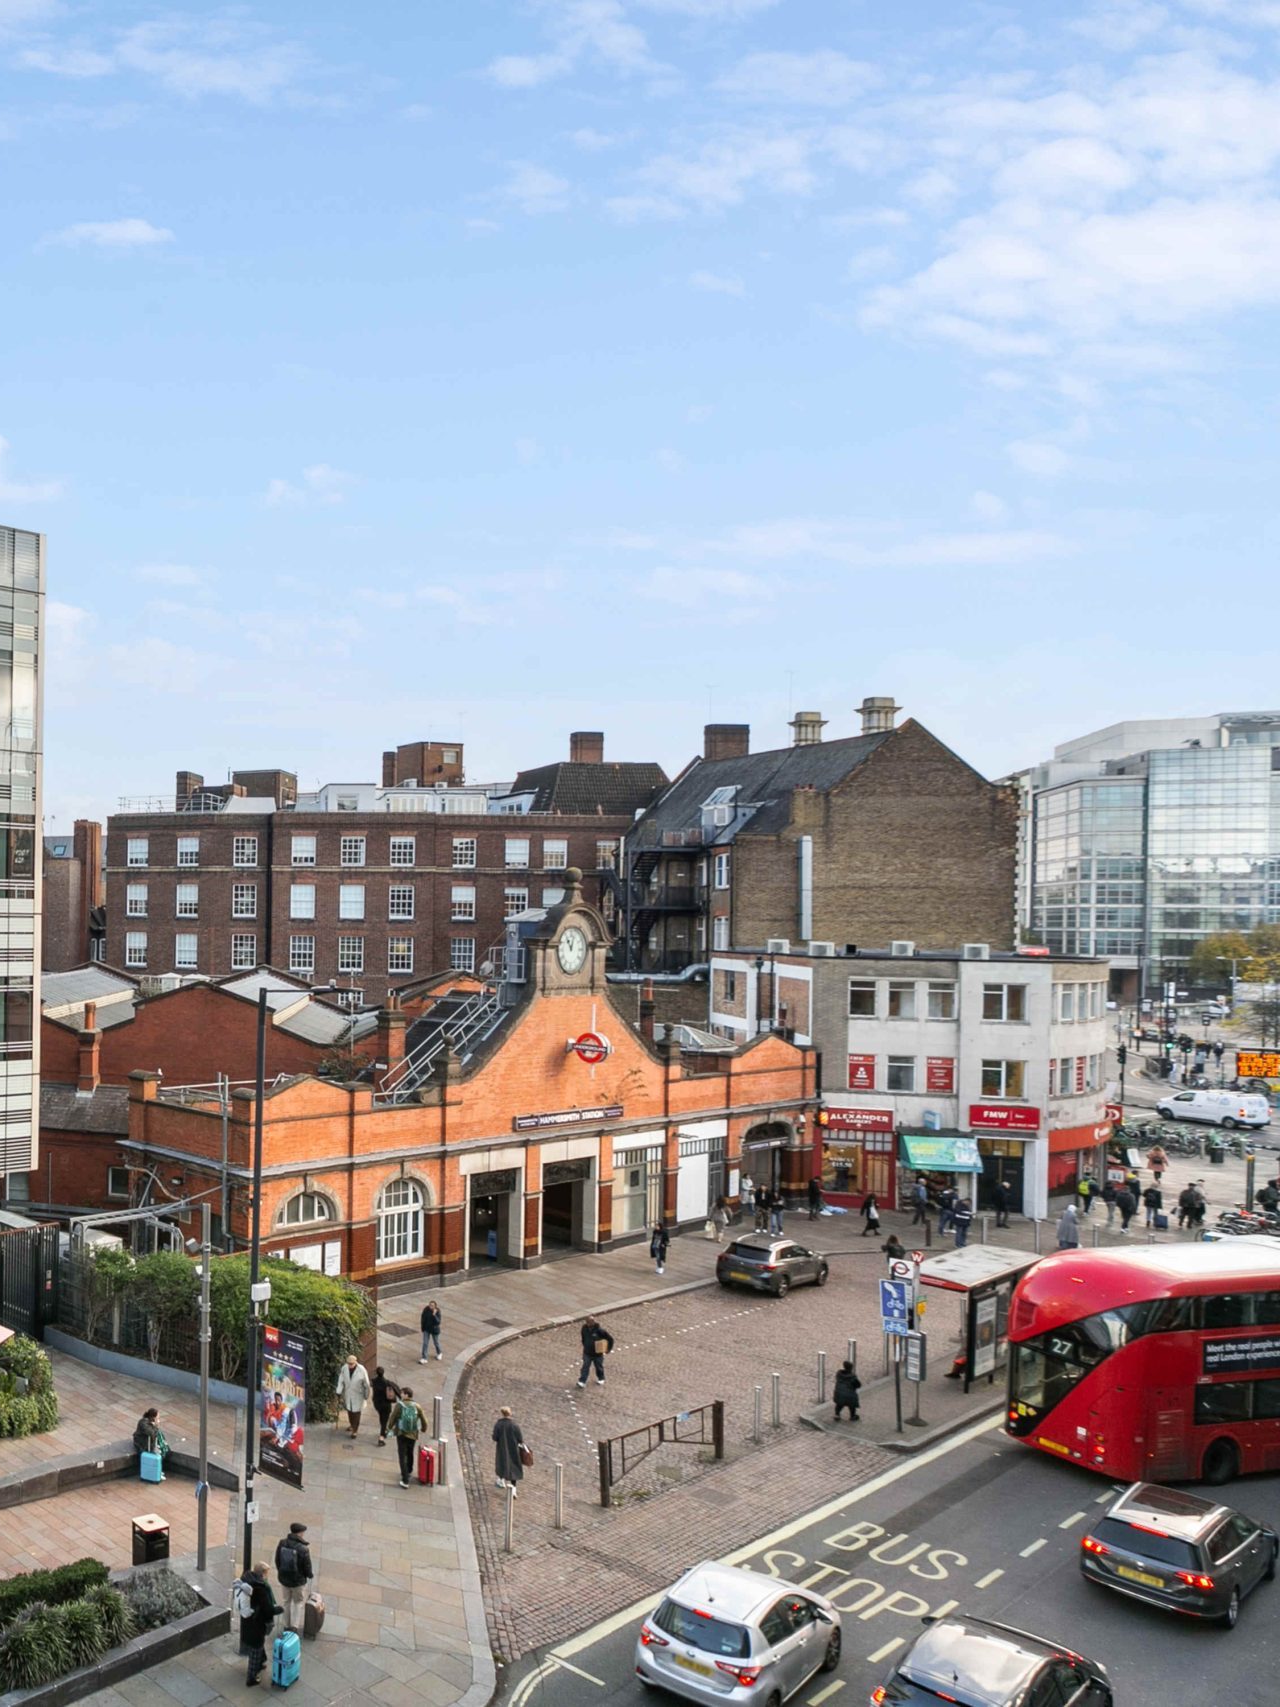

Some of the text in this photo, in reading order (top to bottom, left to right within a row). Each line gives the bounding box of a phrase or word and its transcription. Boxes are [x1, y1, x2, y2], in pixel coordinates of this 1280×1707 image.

[573, 1044, 606, 1052] UNDERGROUND
[540, 1113, 580, 1124] HAMMERSMITH
[582, 1110, 604, 1120] STATION
[829, 1113, 889, 1123] ALEXANDER
[983, 1110, 1008, 1119] FMW
[912, 1252, 922, 1261] W
[1052, 1338, 1072, 1355] 27
[1206, 1343, 1224, 1353] Meet
[1225, 1342, 1237, 1351] the
[1237, 1340, 1250, 1350] real
[1251, 1339, 1273, 1351] people
[1206, 1353, 1220, 1362] real
[1220, 1352, 1246, 1362] London
[823, 1521, 968, 1580] BUS
